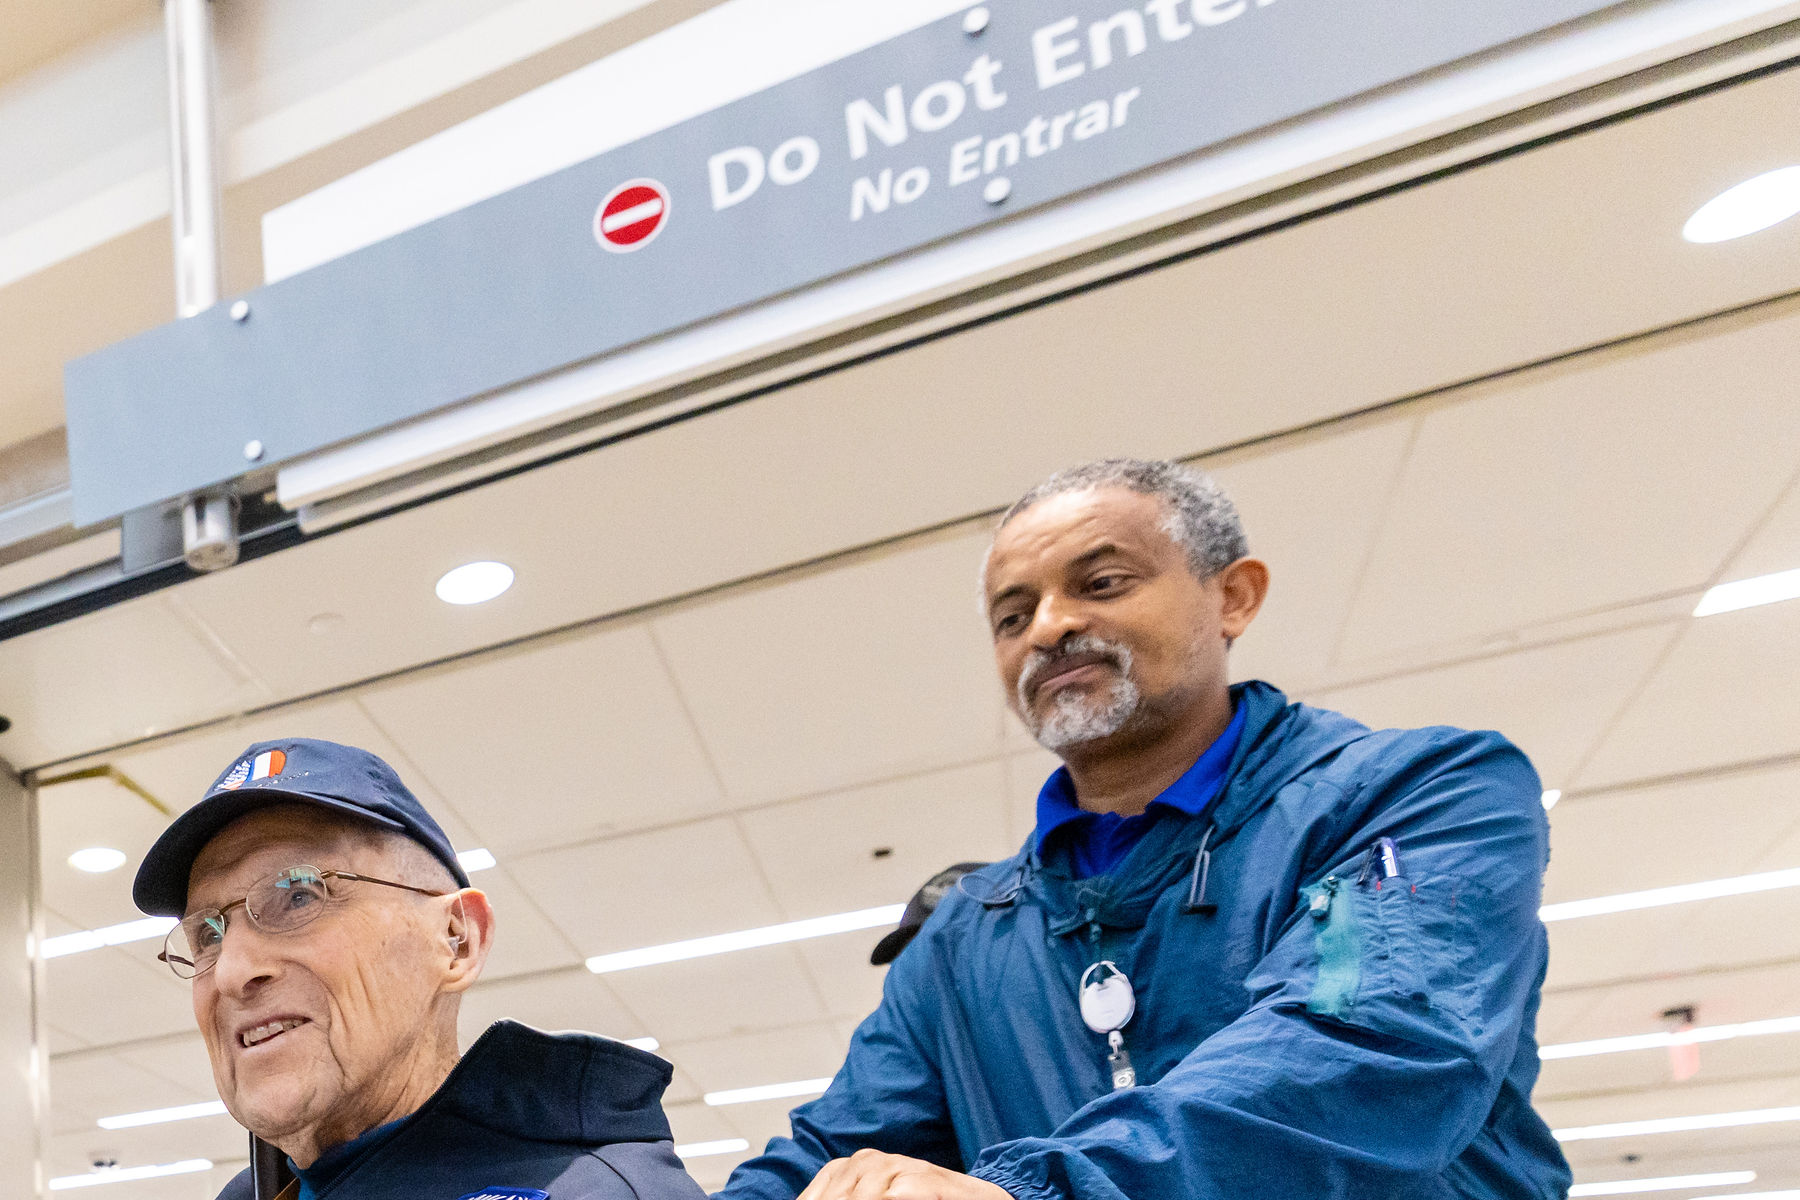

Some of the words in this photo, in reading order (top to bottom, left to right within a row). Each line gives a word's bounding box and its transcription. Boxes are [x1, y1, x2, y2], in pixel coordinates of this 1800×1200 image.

[706, 134, 821, 212] Do
[843, 54, 1008, 161] Not
[1030, 0, 1278, 91] Ente
[847, 164, 931, 222] No
[947, 86, 1142, 186] Entrar
